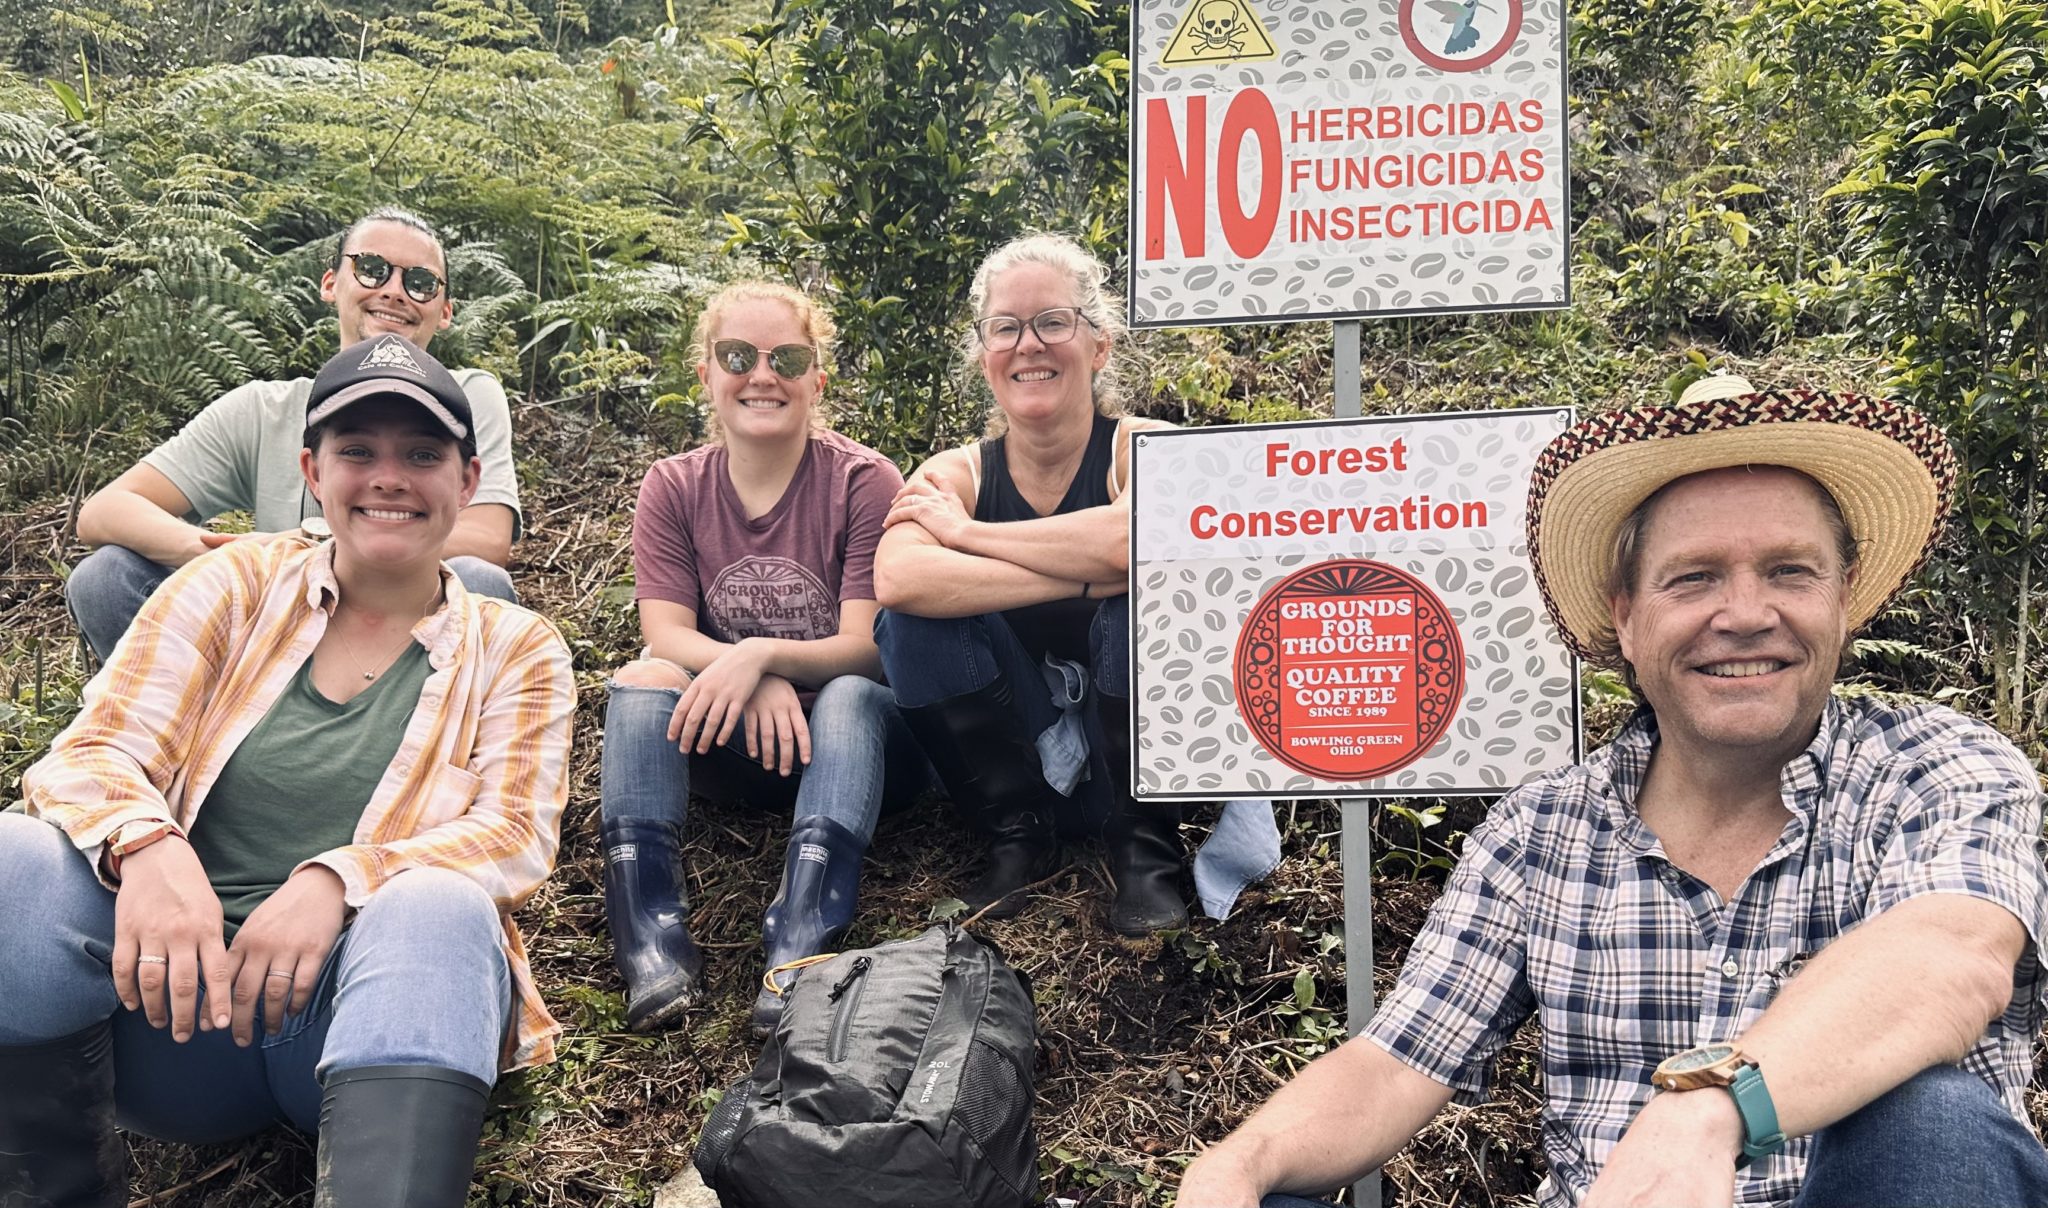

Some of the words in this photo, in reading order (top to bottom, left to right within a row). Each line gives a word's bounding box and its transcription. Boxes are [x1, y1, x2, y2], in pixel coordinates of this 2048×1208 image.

[1291, 100, 1544, 143] HERBICIDAS
[1146, 88, 1282, 260] NO
[1290, 149, 1545, 193] FUNGICIDAS
[1290, 199, 1553, 242] INSECTICIDA
[1267, 438, 1407, 477] Forest
[1189, 496, 1488, 540] Conservation
[727, 583, 803, 596] GROUNDS
[751, 596, 780, 608] FOR
[1281, 599, 1412, 620] GROUNDS
[730, 607, 806, 619] THOUGHT
[1321, 618, 1374, 637] FOR
[1282, 634, 1412, 655] THOUGHT
[1286, 665, 1406, 690] QUALITY
[1295, 687, 1397, 706] COFFEE
[1308, 707, 1352, 718] SINCE
[1356, 706, 1388, 718] 1989
[1291, 735, 1353, 748] BOWLING
[1356, 734, 1403, 747] GREEN
[1329, 745, 1364, 756] OHIO
